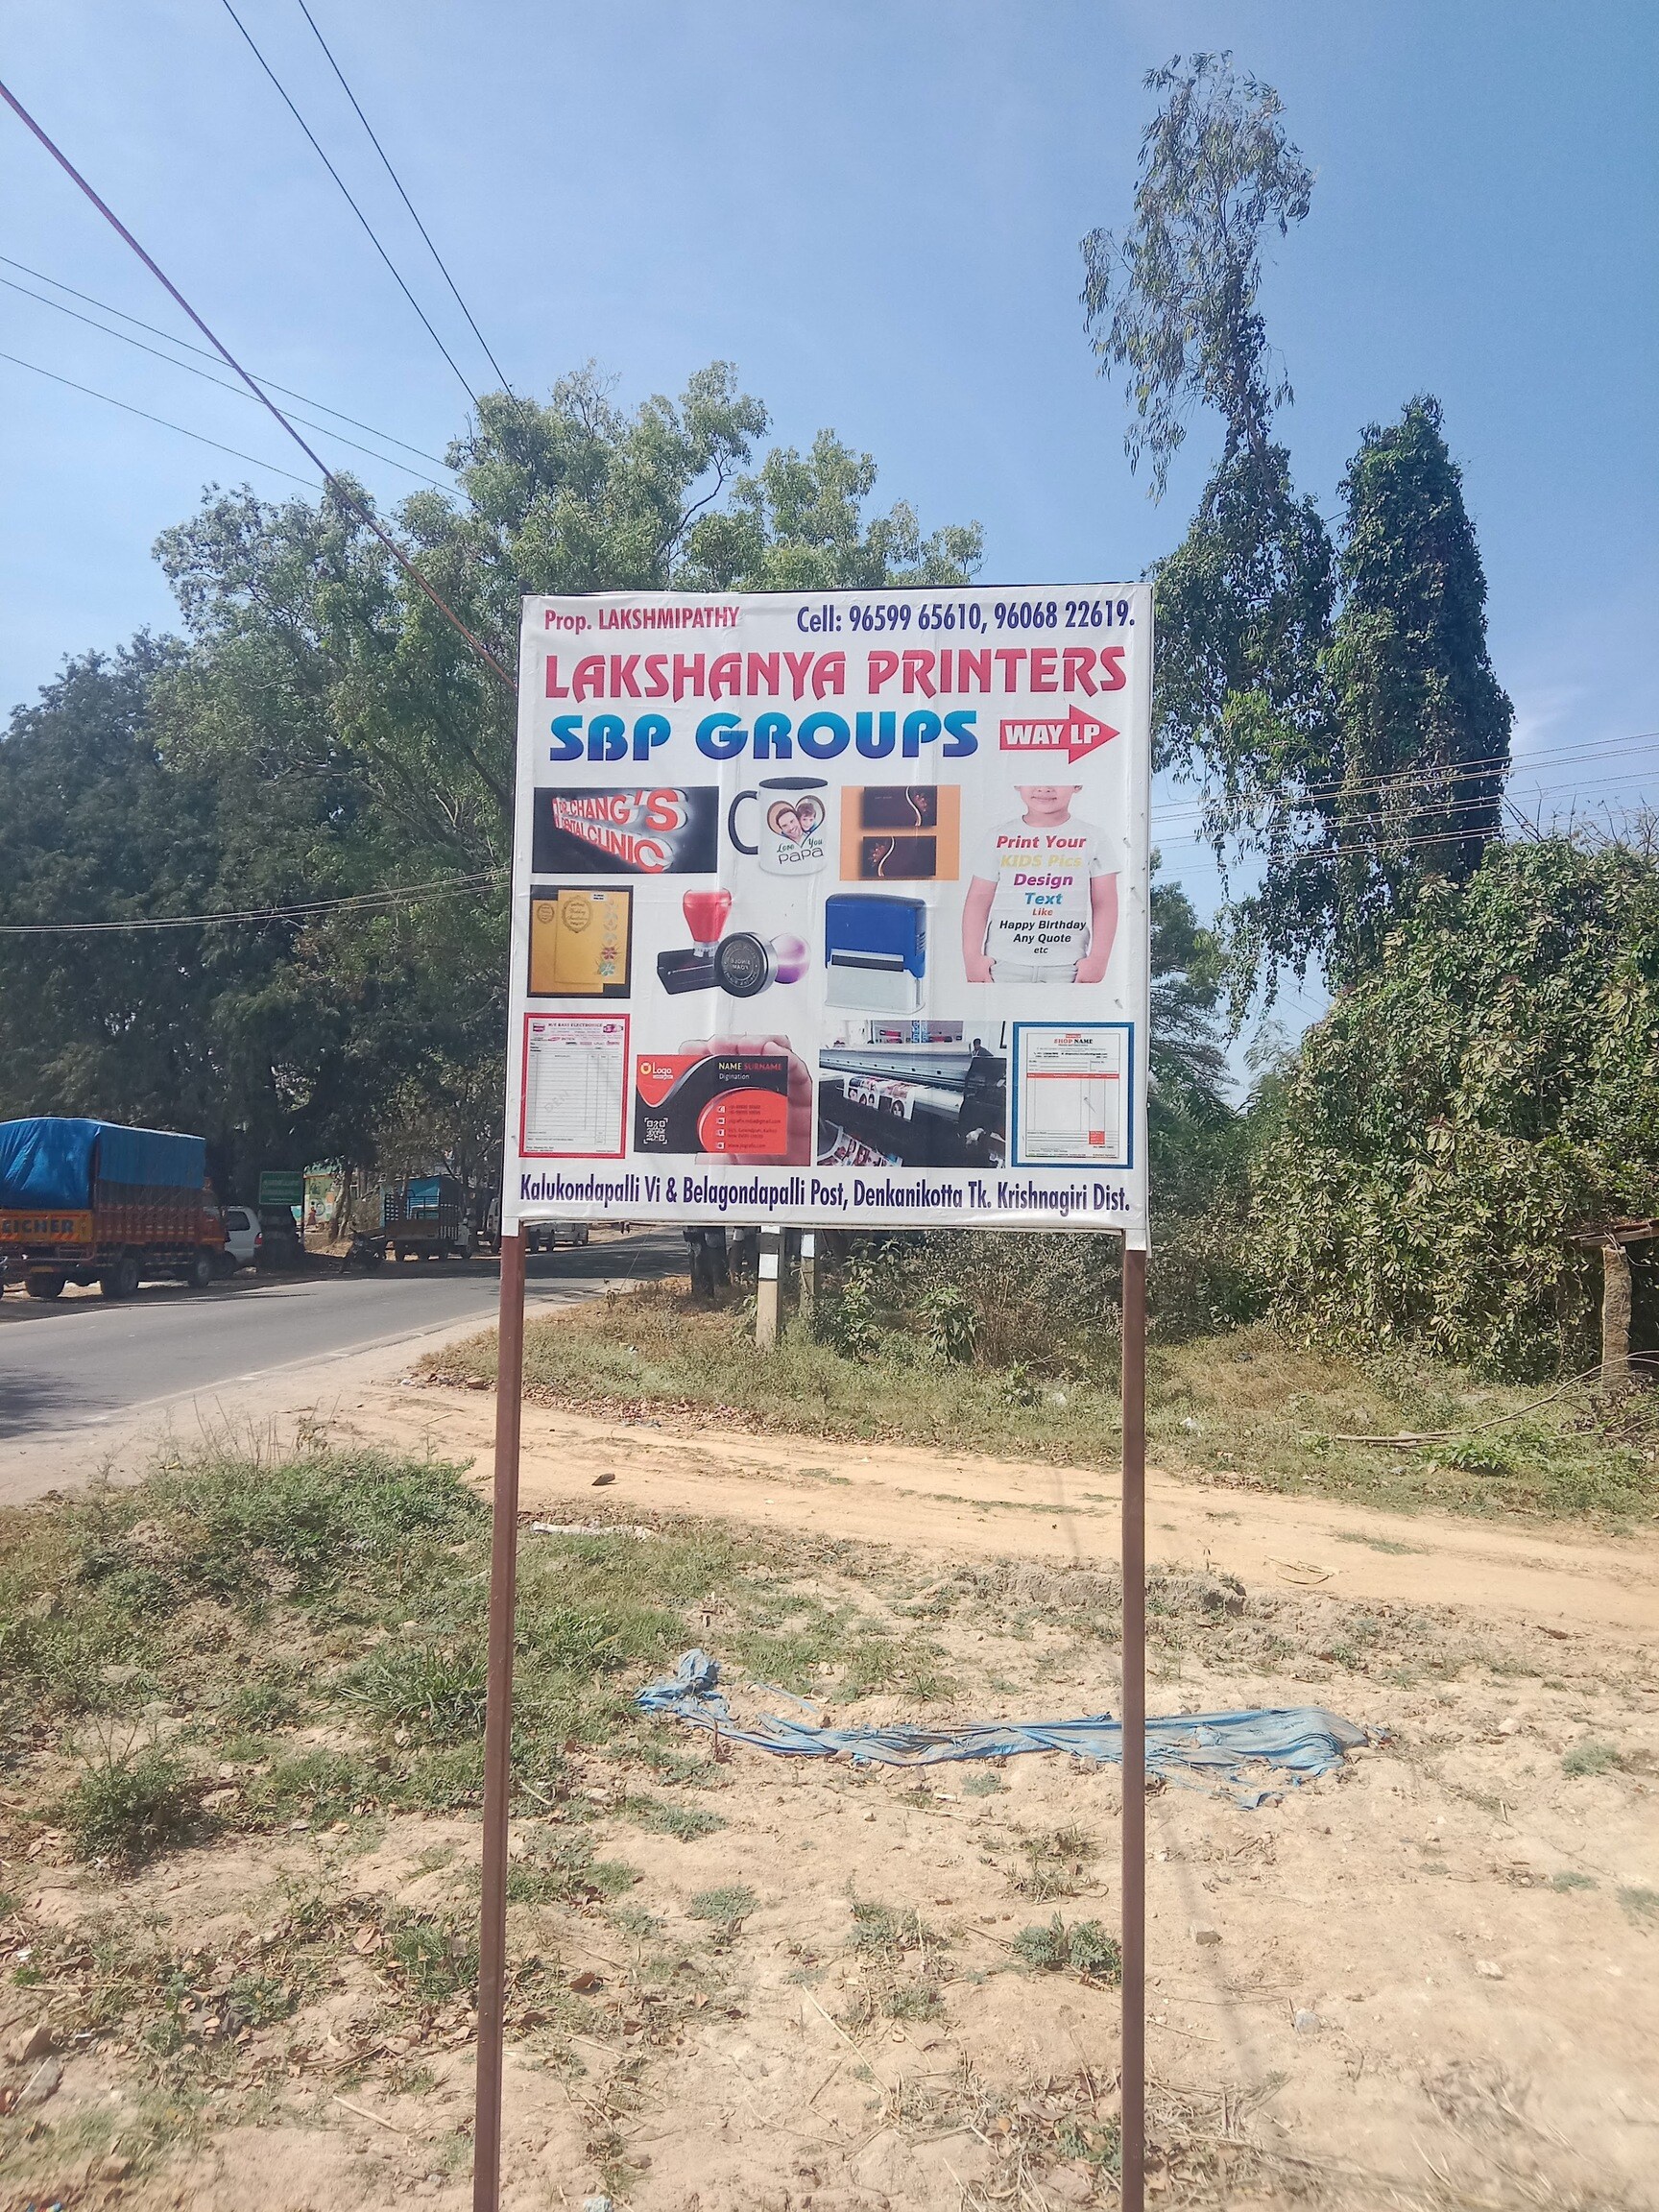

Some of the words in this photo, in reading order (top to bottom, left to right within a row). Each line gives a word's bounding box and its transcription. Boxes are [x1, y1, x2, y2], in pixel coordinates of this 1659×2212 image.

[545, 609, 591, 635] Prop.
[599, 607, 739, 630] LAKSHMIPATHY
[797, 604, 841, 632] Cell:
[850, 604, 911, 632] 96599
[919, 603, 987, 634] 65610,
[995, 601, 1057, 629] 96068
[1065, 600, 1135, 628] 22619.
[545, 651, 846, 704] LAKSHANYA
[868, 646, 1126, 699] PRINTERS
[550, 713, 671, 761] SBP
[695, 709, 978, 760] GROUPS
[1004, 724, 1064, 745] WAY
[1070, 723, 1101, 745] LP
[807, 838, 823, 849] You
[997, 835, 1040, 848] Print
[1046, 835, 1086, 848] Your
[588, 825, 670, 873] CLINIC
[1000, 854, 1043, 868] KIDS
[1047, 854, 1083, 867] Pics
[1014, 873, 1073, 889] Design
[1024, 892, 1063, 904] Text
[1032, 907, 1053, 916] Like
[999, 920, 1036, 930] Happy
[1038, 920, 1086, 930] Birthday
[1013, 933, 1035, 944] Any
[1038, 933, 1071, 944] Quote
[653, 1062, 672, 1075] Logo
[718, 1062, 743, 1070] NAME
[520, 1172, 639, 1209] Kalukondapalli
[644, 1175, 661, 1202] Vi
[665, 1176, 678, 1203] &
[683, 1175, 805, 1211] Belagondapalli
[810, 1178, 849, 1211] Post,
[854, 1178, 963, 1208] Denkanikotta
[968, 1180, 992, 1209] Tk.
[998, 1181, 1088, 1216] Krishnagiri
[1093, 1183, 1130, 1212] Dist.
[2, 1219, 75, 1234] EICHER
